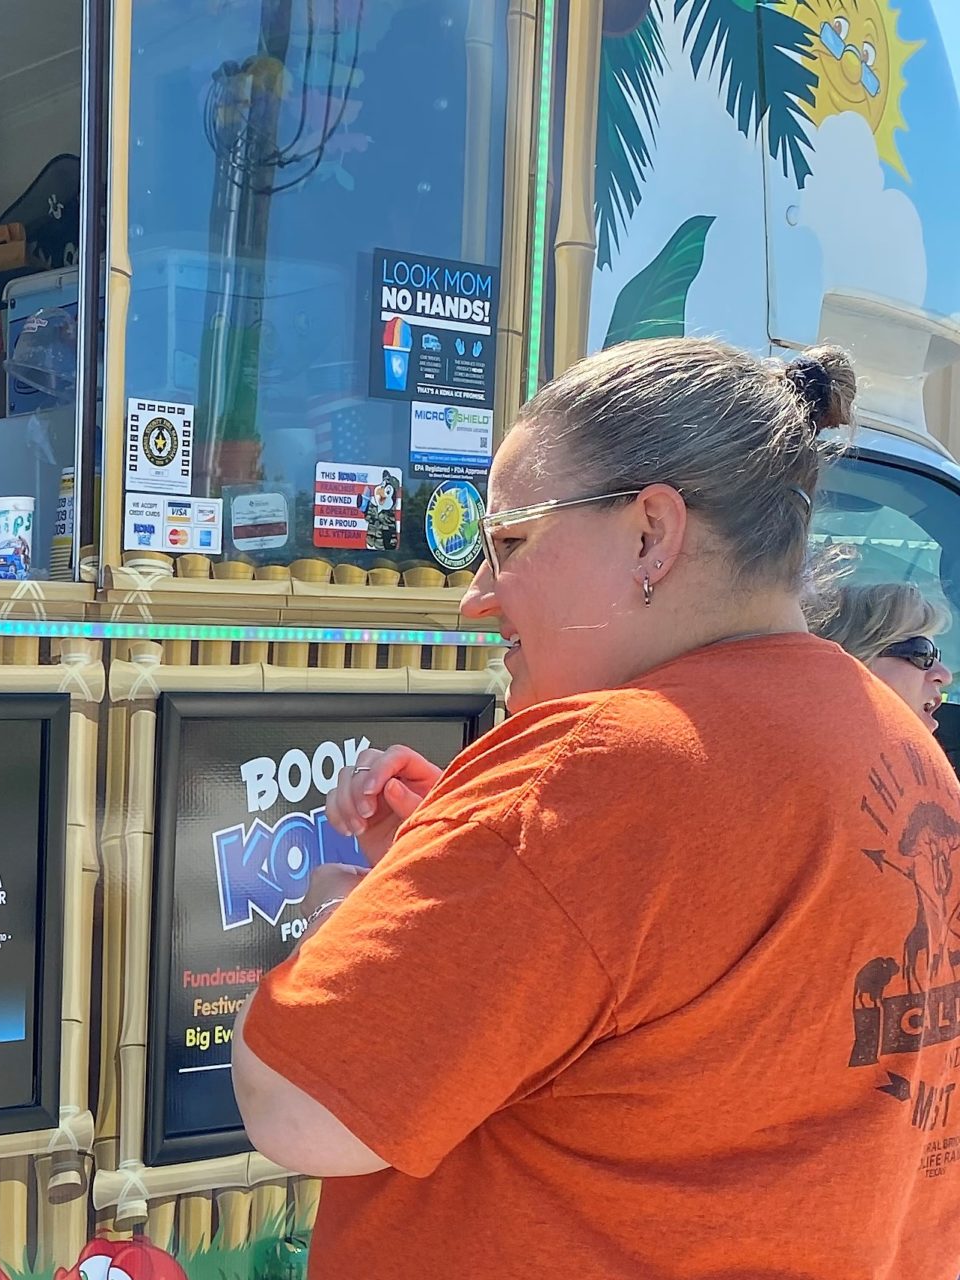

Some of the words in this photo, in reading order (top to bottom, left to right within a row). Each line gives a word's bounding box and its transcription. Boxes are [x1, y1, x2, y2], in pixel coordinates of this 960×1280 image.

[382, 258, 440, 290] LOOK
[444, 269, 492, 298] MOM
[381, 286, 412, 311] NO
[416, 291, 490, 323] HANDS!
[321, 471, 336, 480] THIS
[327, 495, 352, 504] OWNED
[171, 508, 188, 516] VISA
[319, 518, 327, 526] BY
[335, 520, 357, 528] PROUD
[185, 1027, 210, 1050] Big
